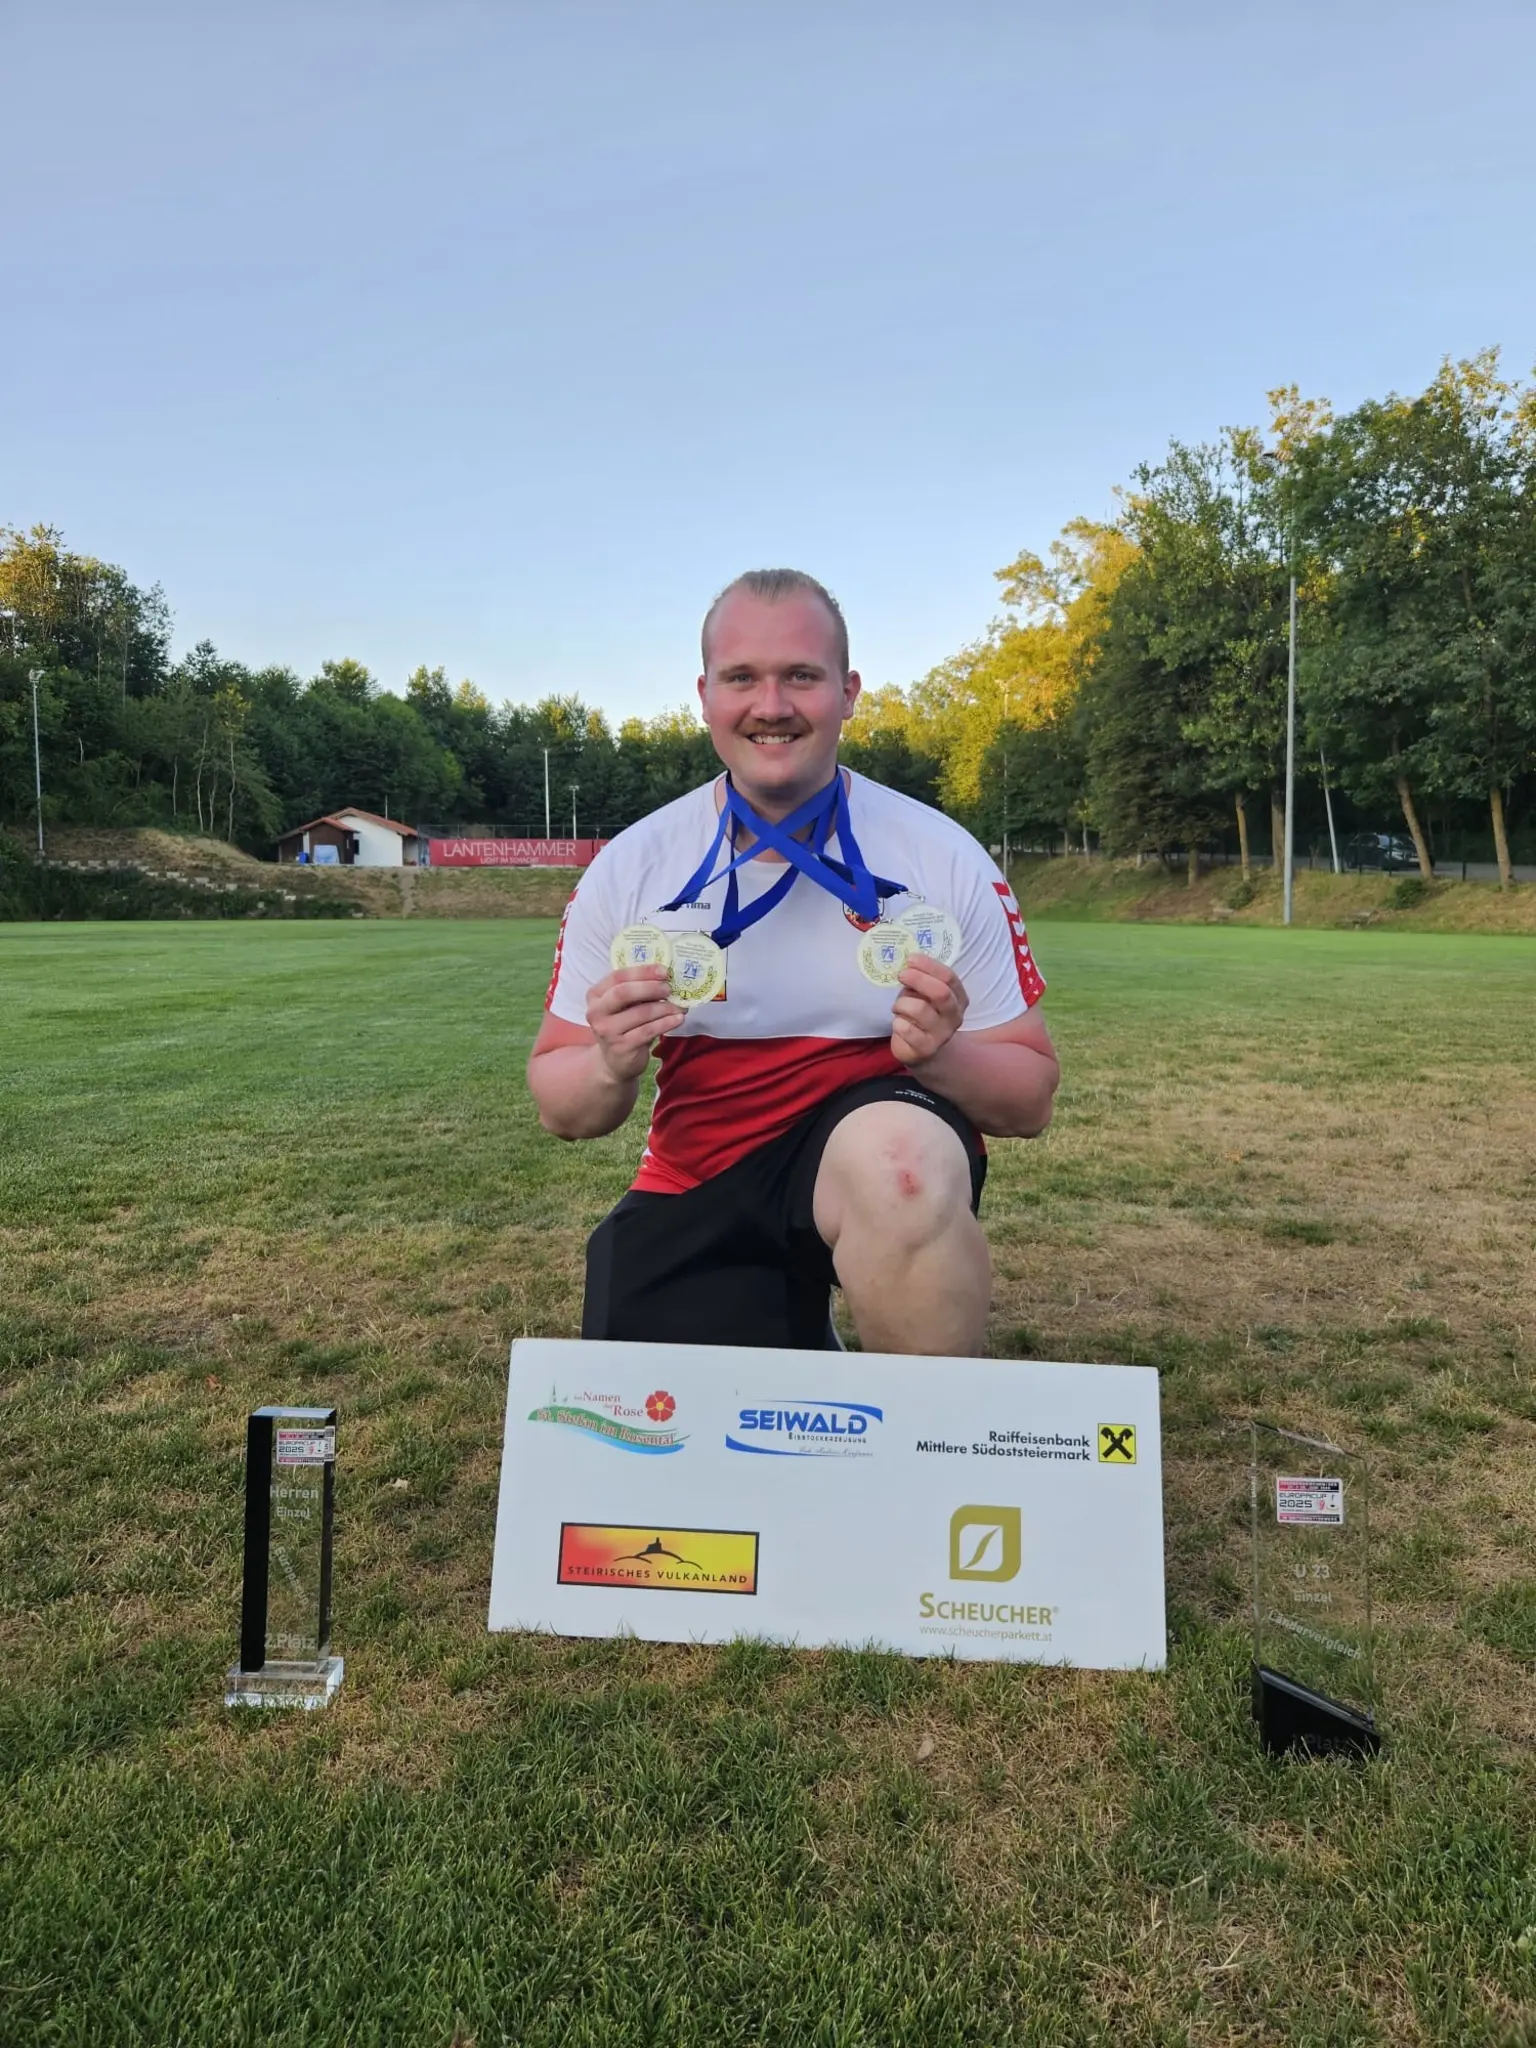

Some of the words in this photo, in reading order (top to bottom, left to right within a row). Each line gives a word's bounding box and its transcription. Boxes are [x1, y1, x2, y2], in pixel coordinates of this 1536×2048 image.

[443, 842, 576, 857] LANTENHAMMER
[583, 1391, 620, 1403] Namen
[613, 1404, 644, 1417] Rose
[557, 1409, 598, 1432] Stefan
[739, 1409, 868, 1435] SEIWALD
[989, 1430, 1091, 1448] Raiffeisenbank
[916, 1441, 968, 1454] Mittlere
[972, 1443, 1091, 1461] Südoststeiermark
[269, 1485, 319, 1499] Herren
[1279, 1500, 1313, 1508] 2025
[275, 1506, 312, 1519] Einzel
[568, 1565, 651, 1579] STEIRISCHES
[657, 1570, 748, 1584] VULKANLAND
[919, 1625, 1053, 1642] www.scheucherparkett.at
